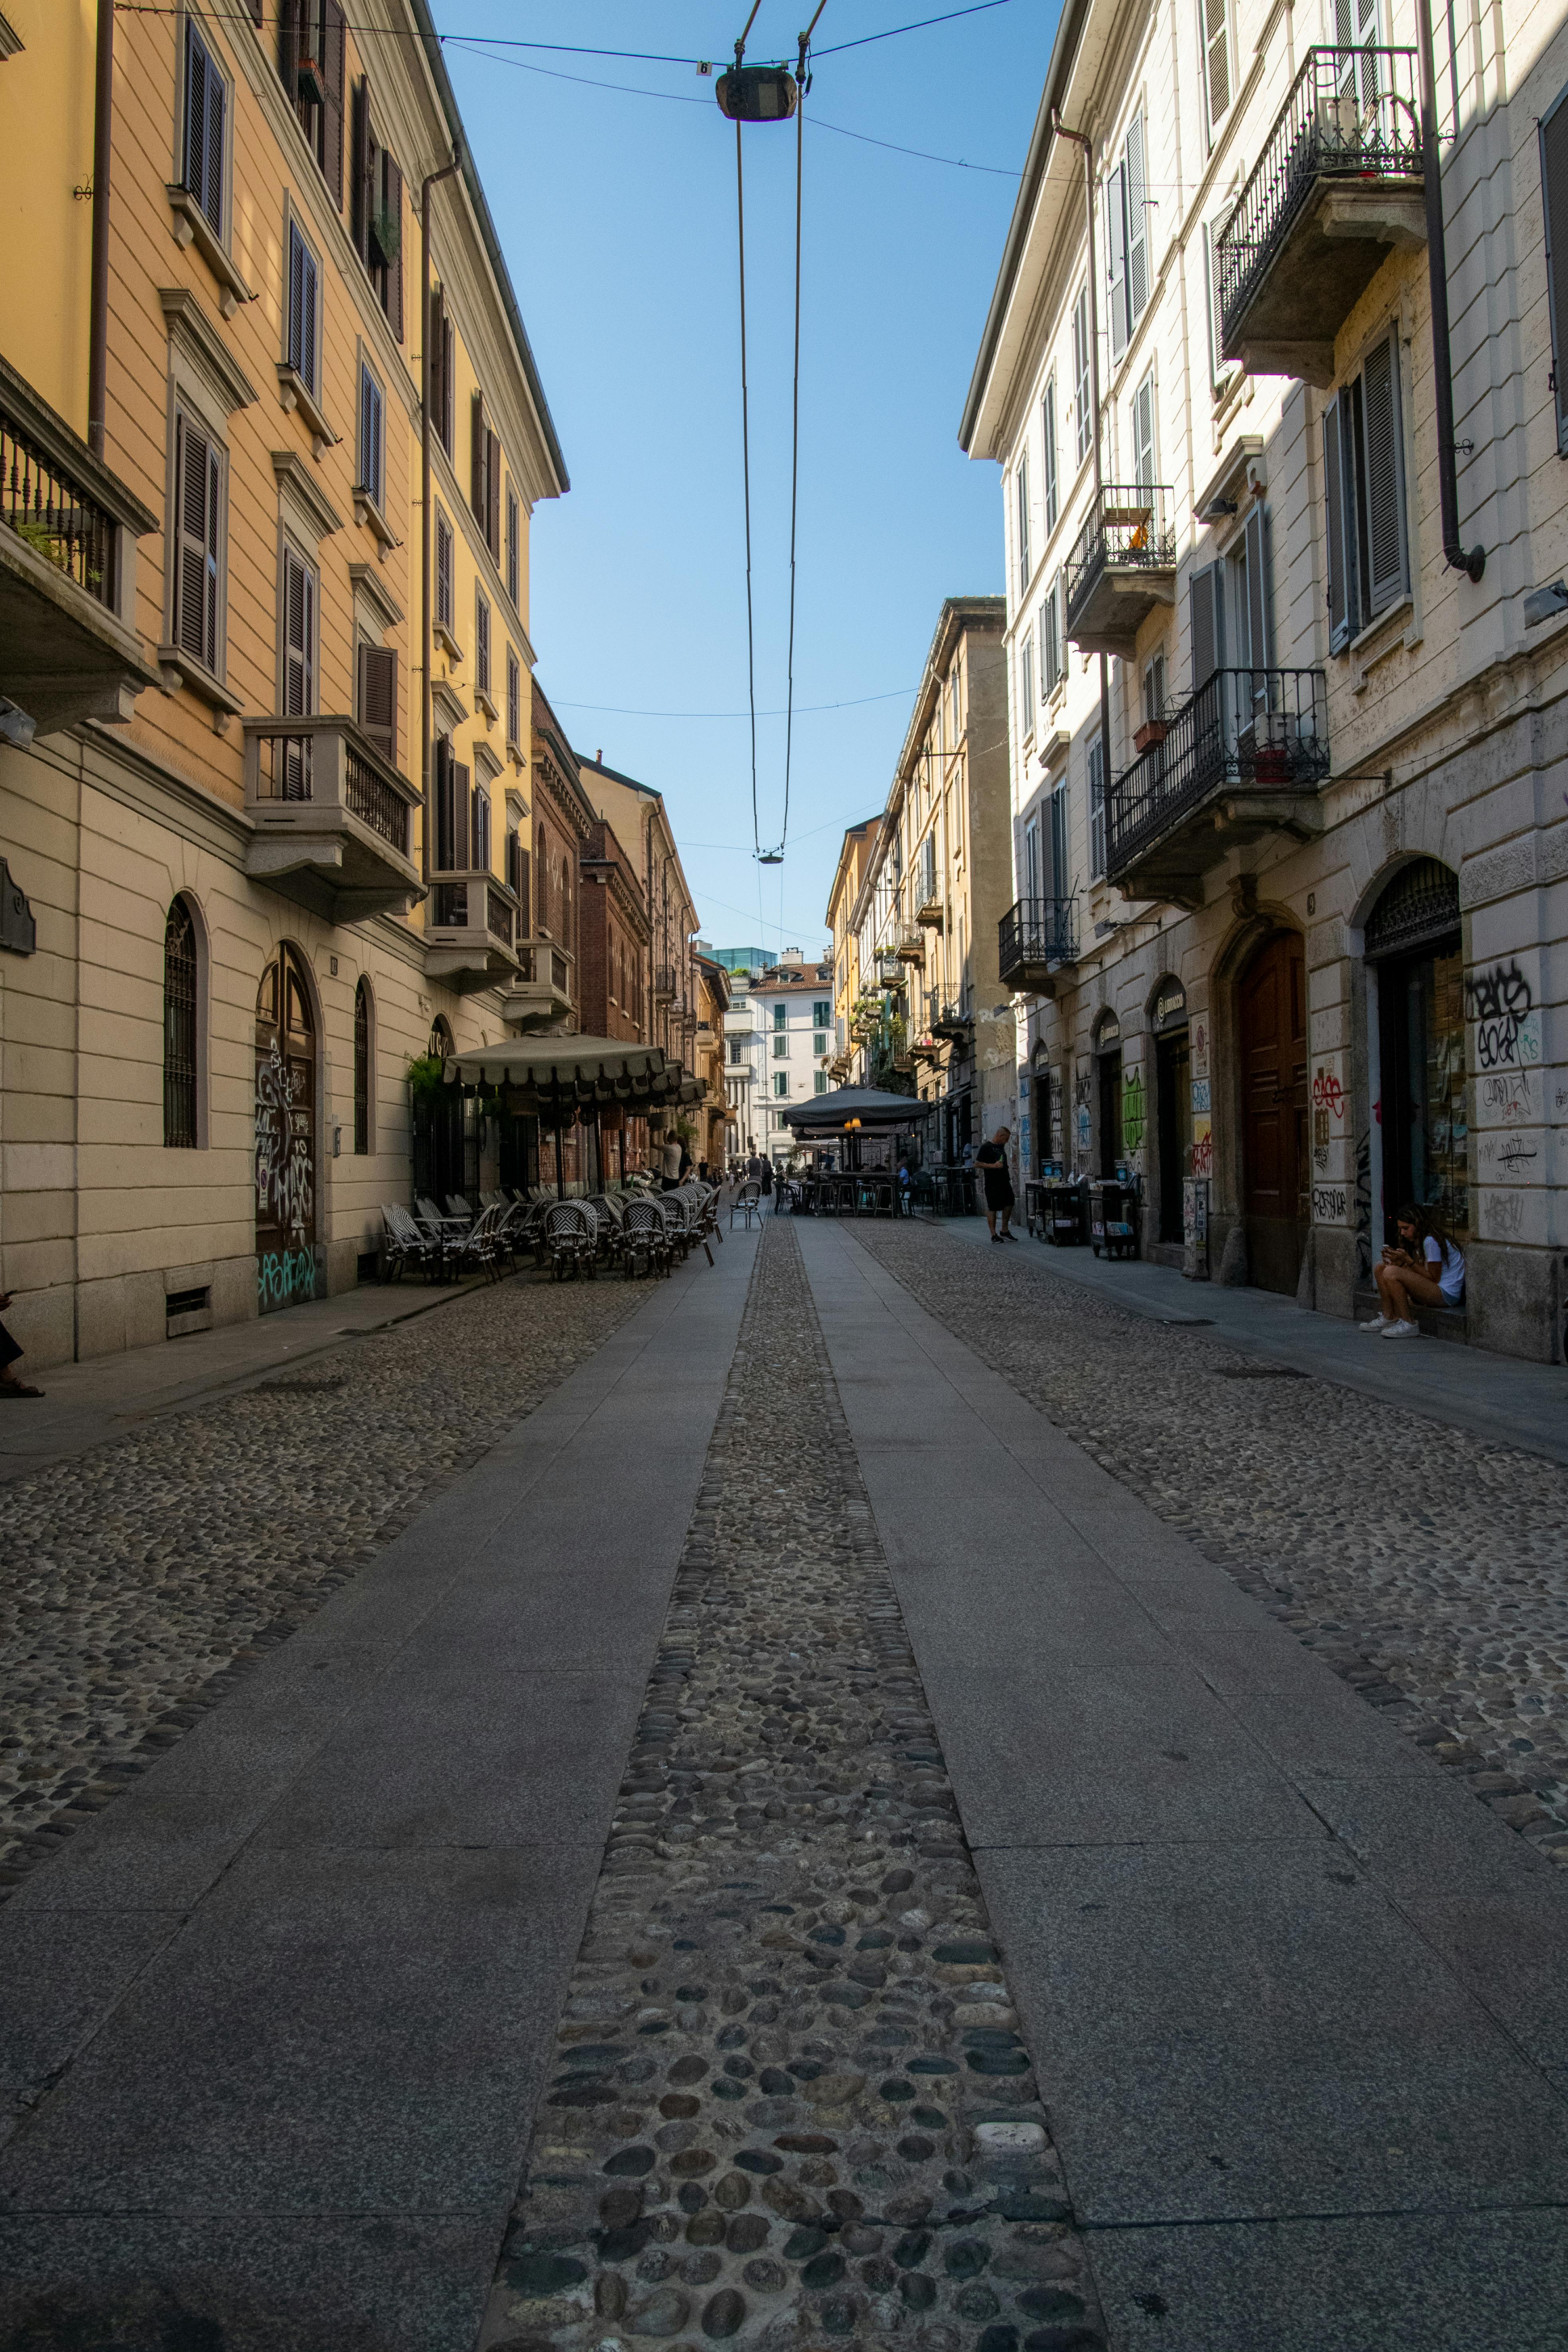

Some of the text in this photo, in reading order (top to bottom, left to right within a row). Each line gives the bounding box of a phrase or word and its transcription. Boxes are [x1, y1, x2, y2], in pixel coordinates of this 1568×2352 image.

[701, 63, 708, 73] 6
[332, 959, 337, 974] 12
[1165, 993, 1183, 1014] LIBRACCIO
